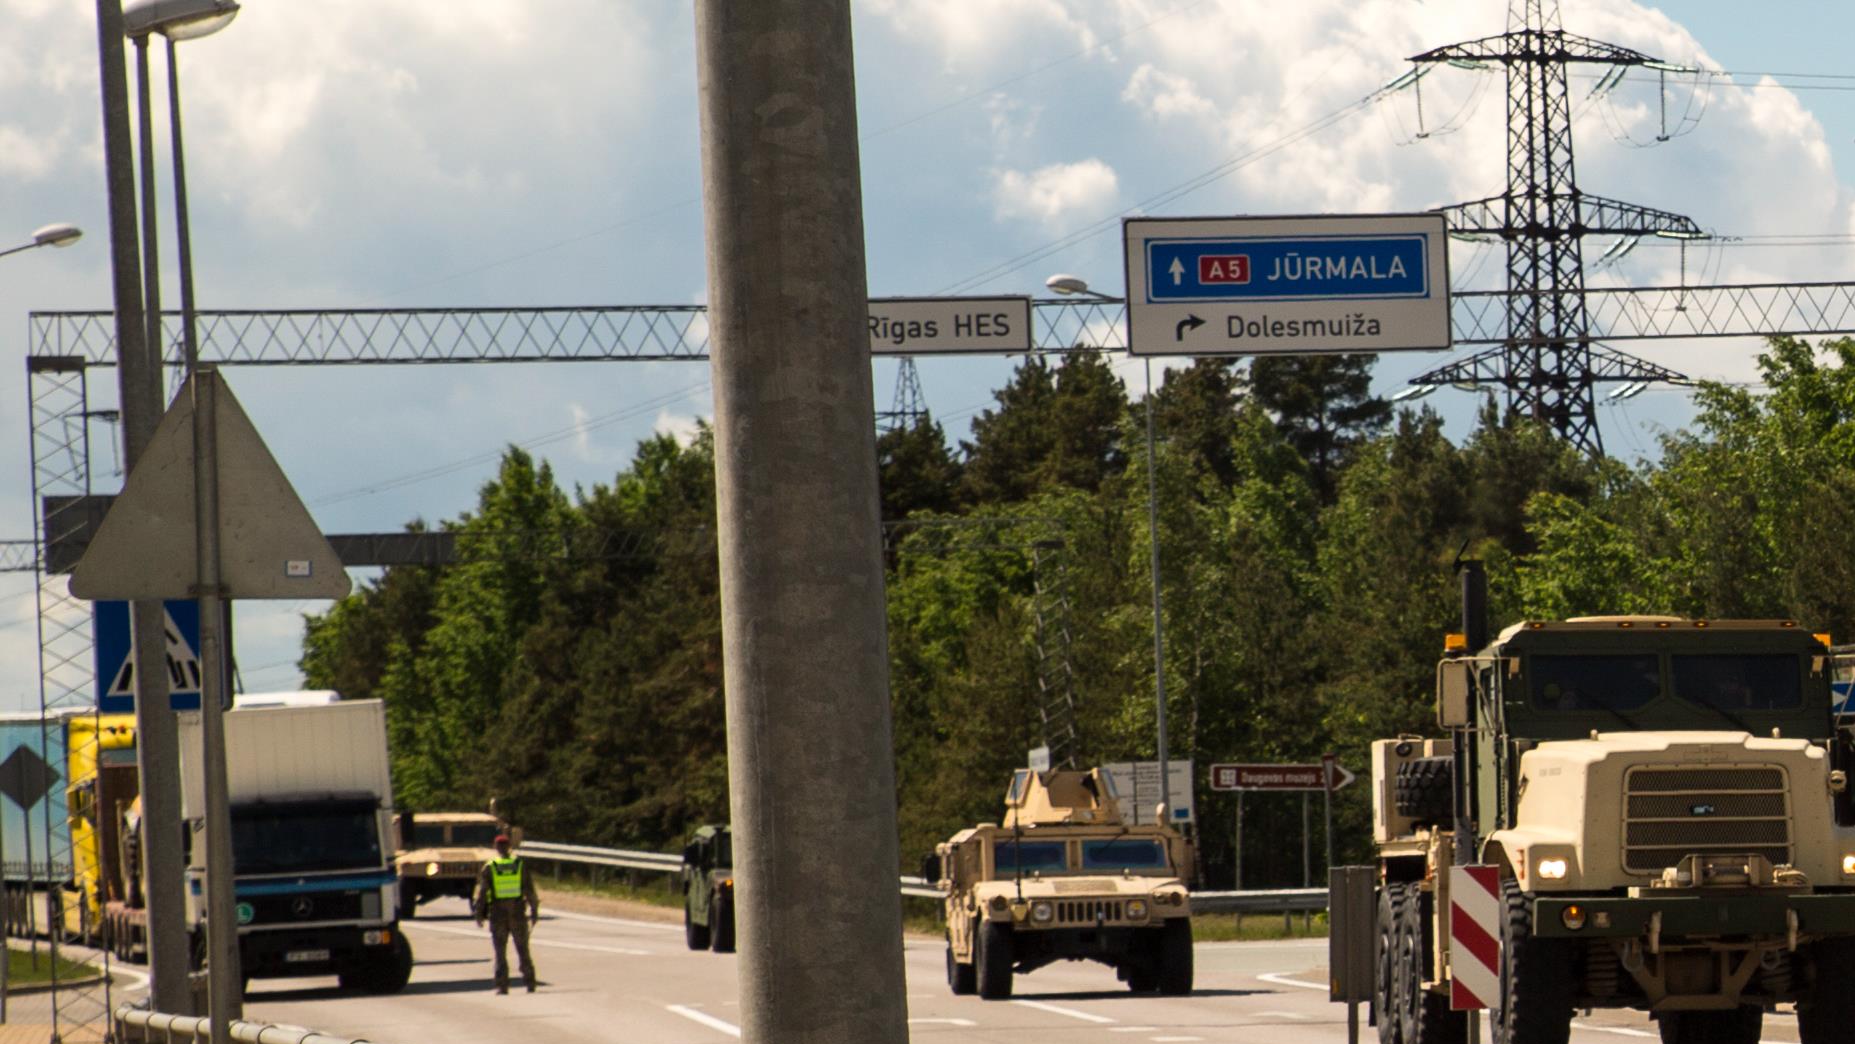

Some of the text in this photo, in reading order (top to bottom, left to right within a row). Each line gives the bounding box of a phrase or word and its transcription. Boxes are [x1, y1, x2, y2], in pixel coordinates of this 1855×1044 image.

[1208, 253, 1407, 281] A5 JŪRMALA
[868, 313, 1011, 345] Rīgas HES
[1227, 313, 1381, 339] Dolesmuiža
